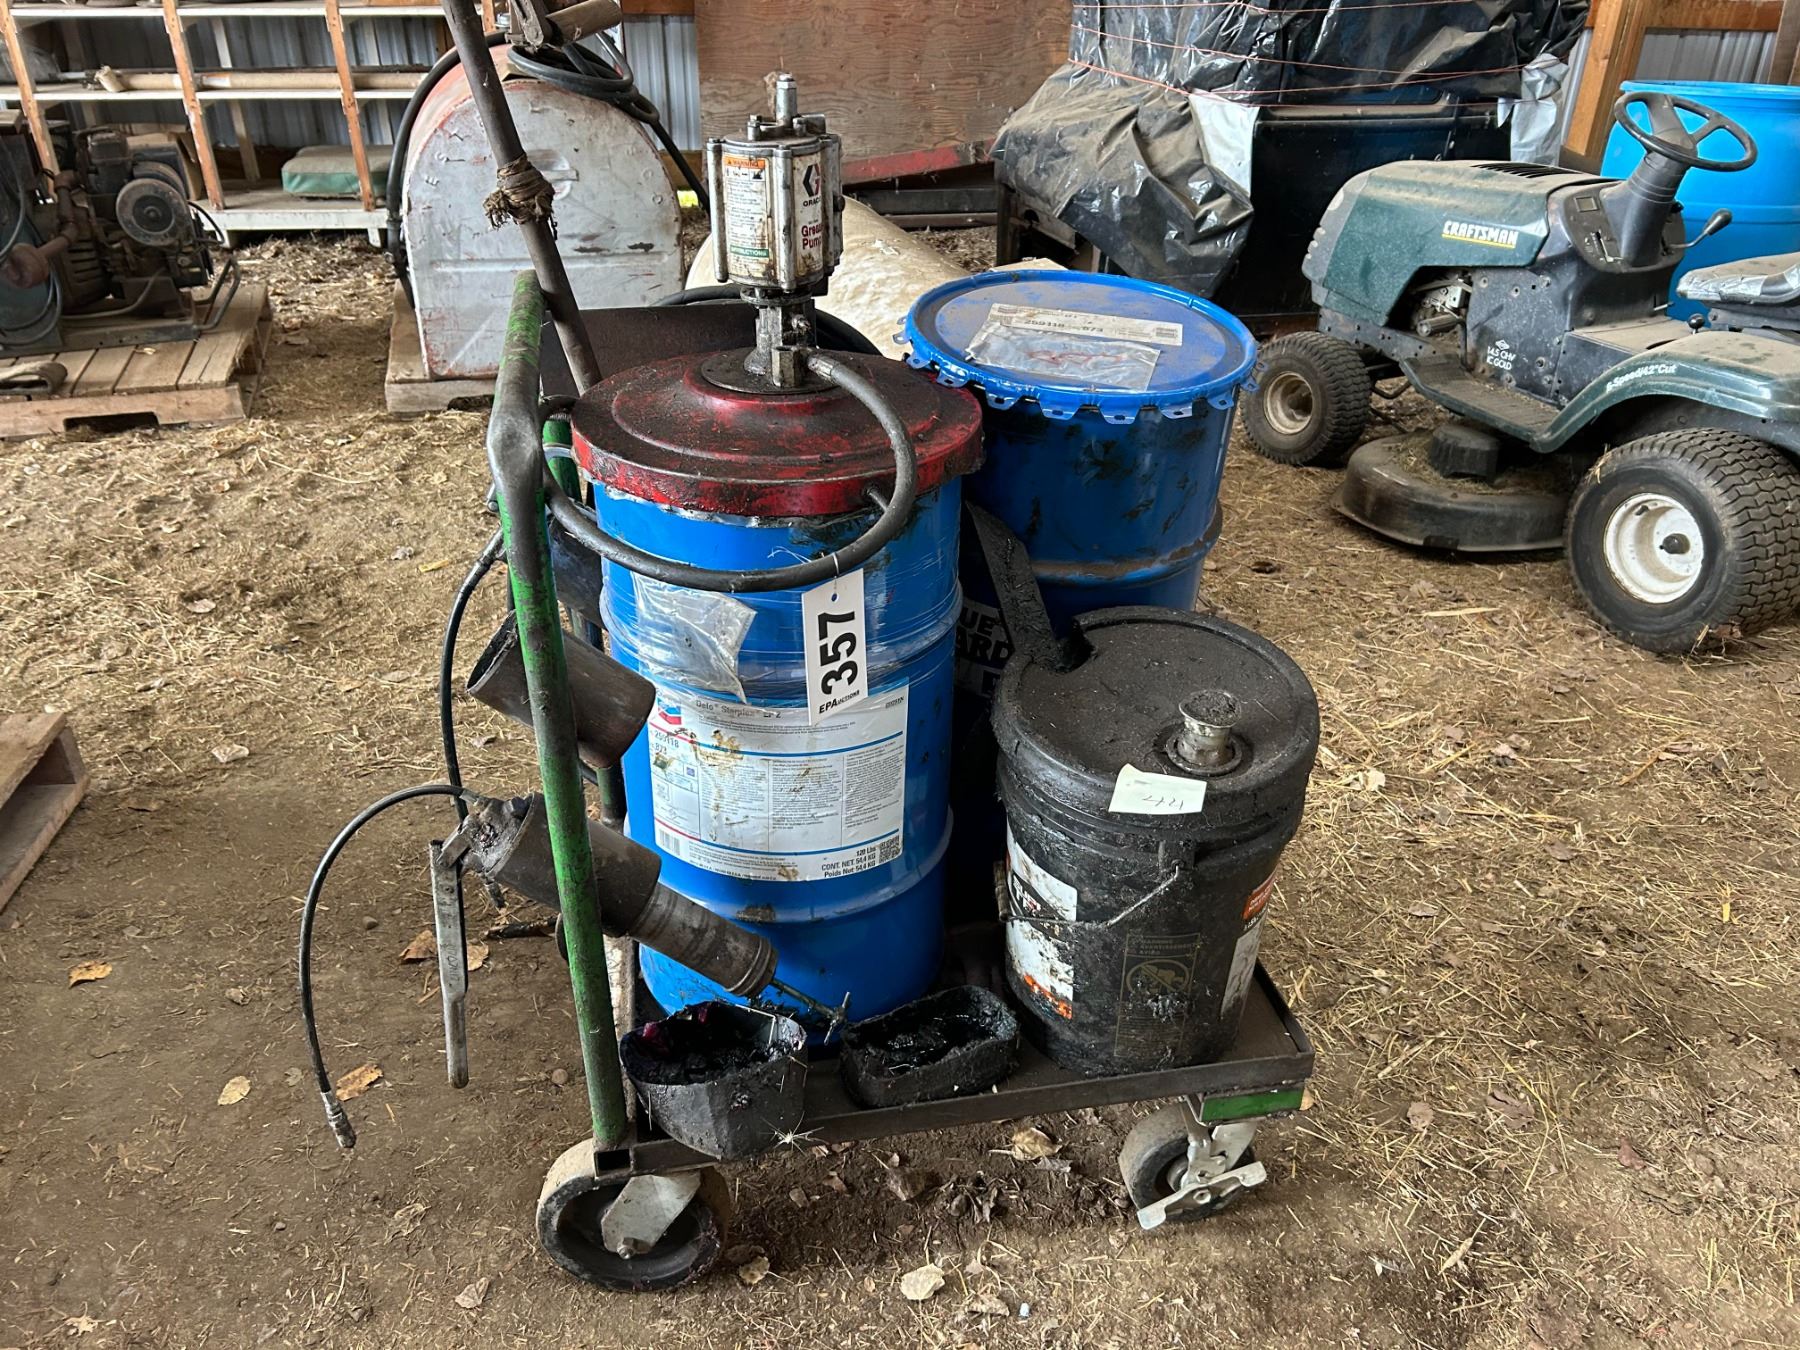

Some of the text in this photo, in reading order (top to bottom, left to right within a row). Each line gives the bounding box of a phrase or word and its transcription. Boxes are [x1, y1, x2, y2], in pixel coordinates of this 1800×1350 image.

[803, 197, 821, 207] GRAC
[1442, 220, 1519, 245] CRAFTSMAN
[1493, 358, 1512, 370] GOLD
[817, 610, 859, 695] 357
[867, 852, 876, 861] KG
